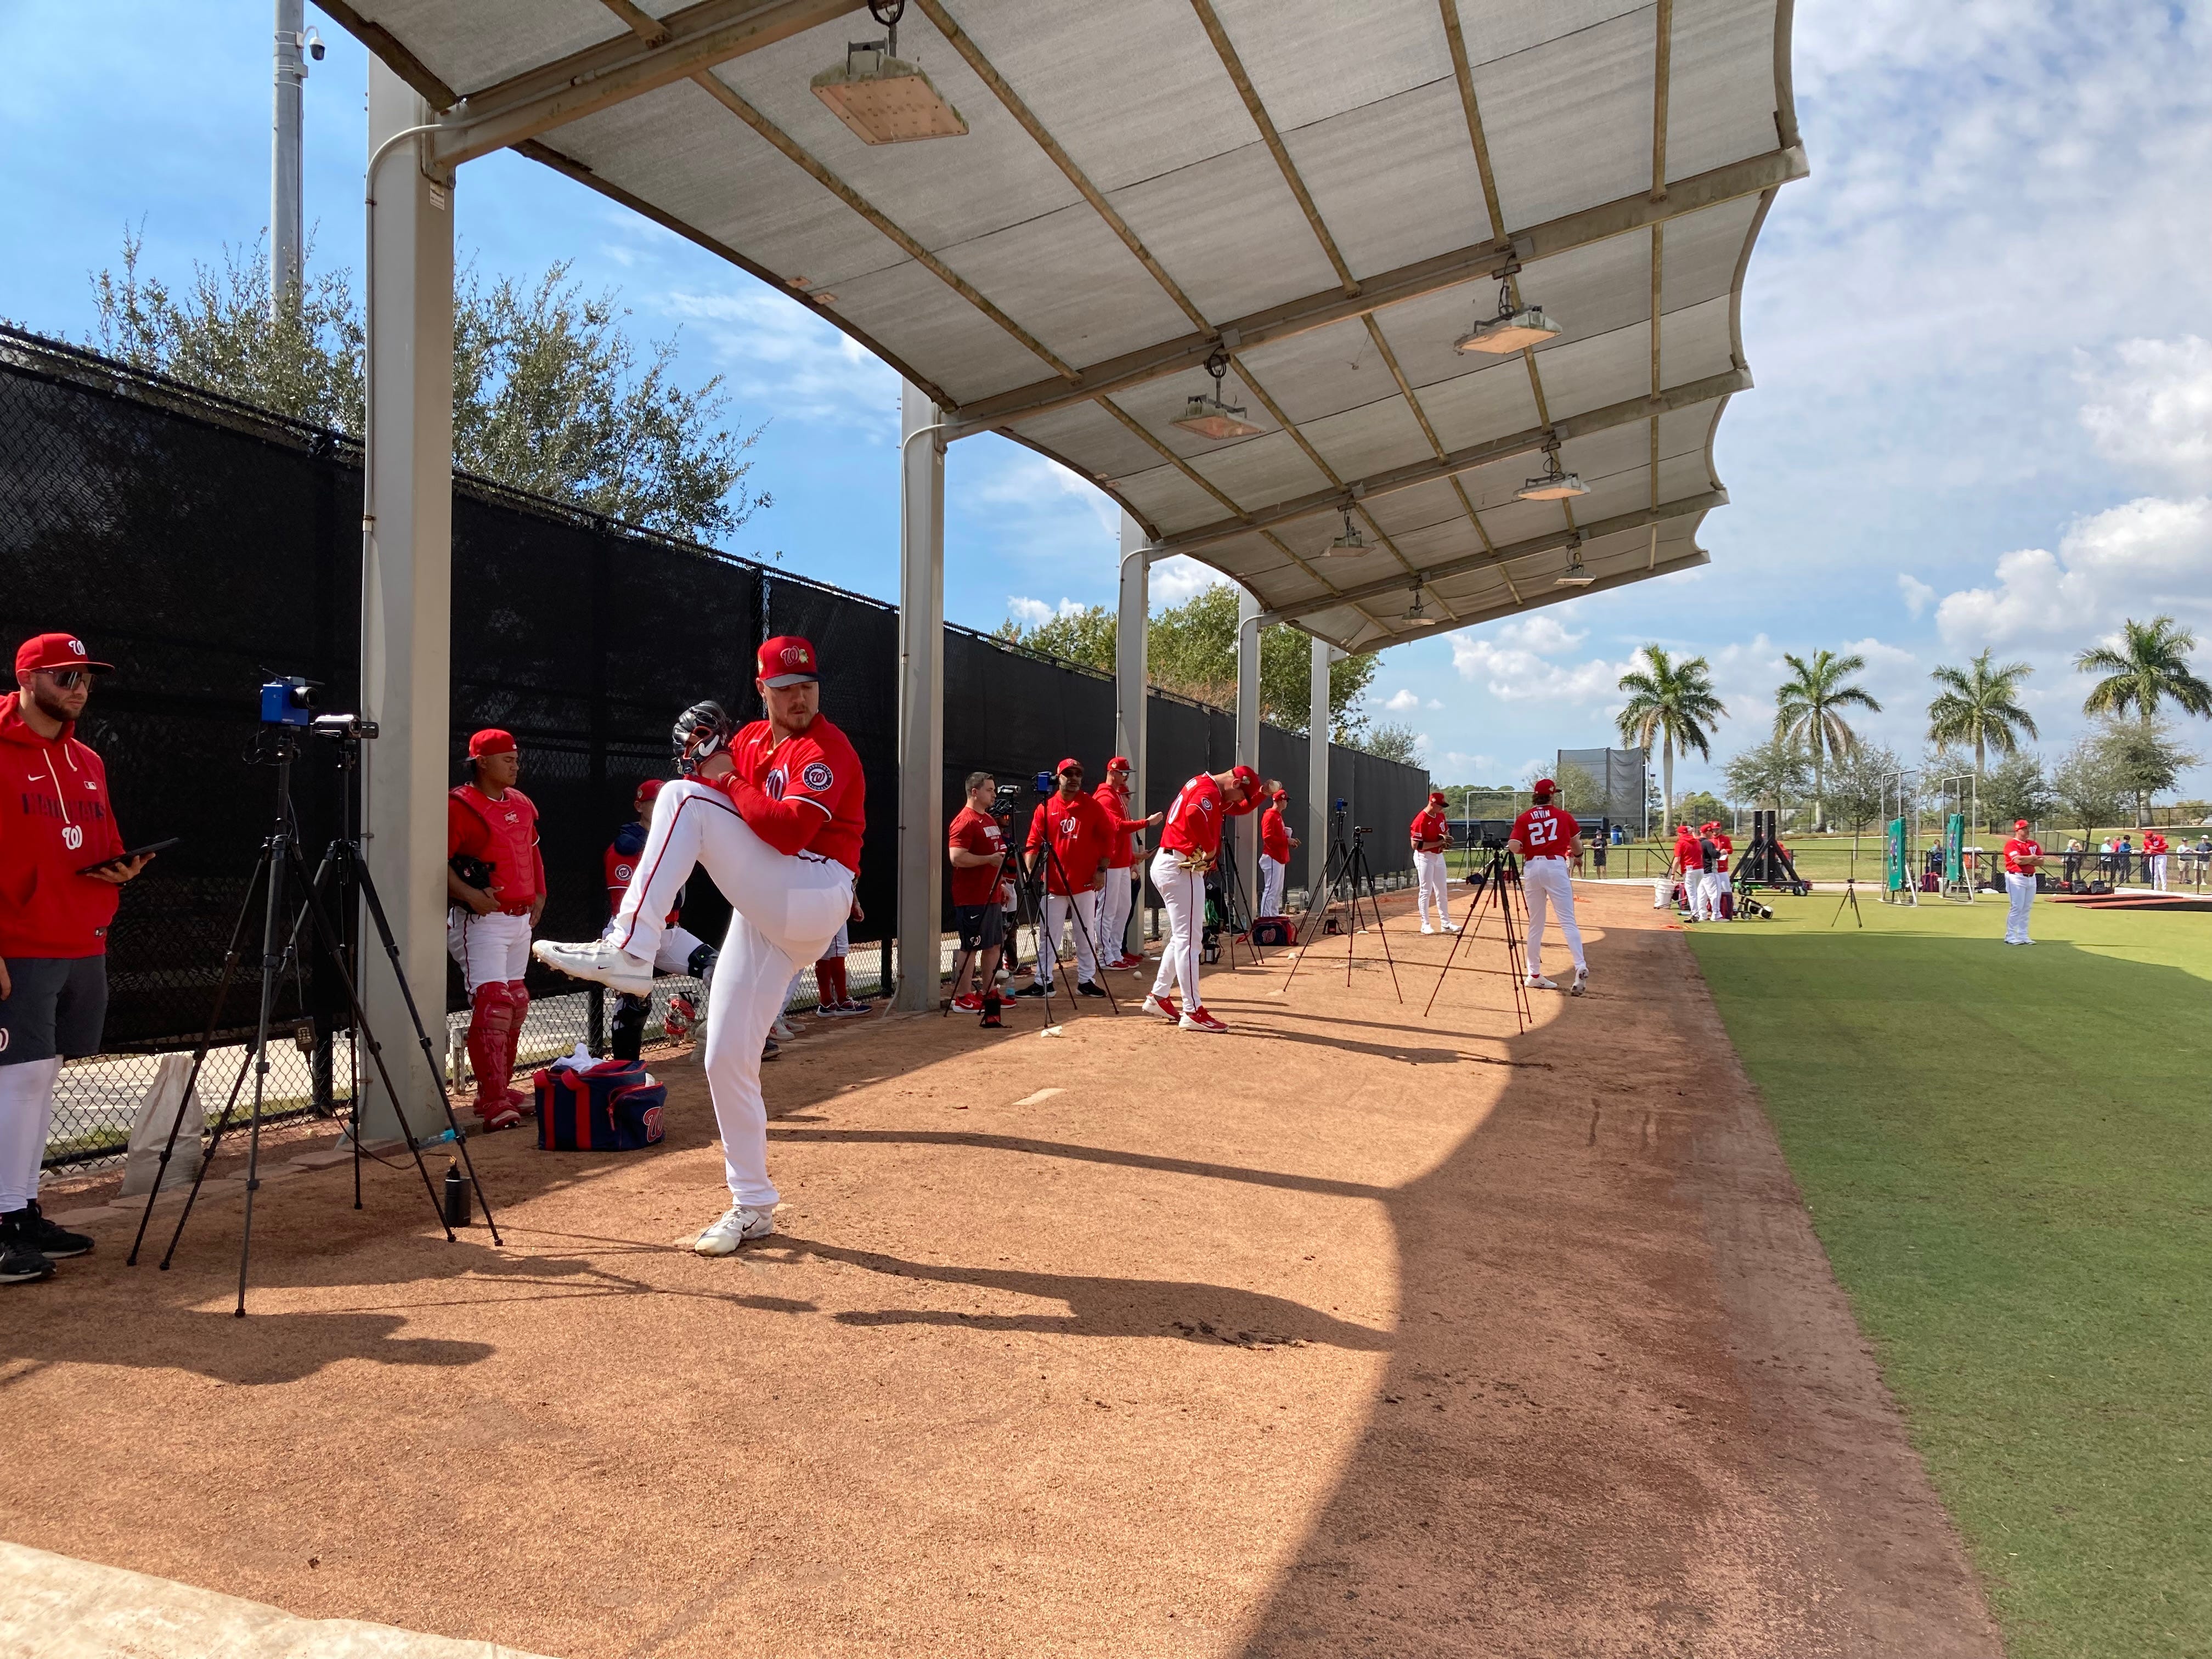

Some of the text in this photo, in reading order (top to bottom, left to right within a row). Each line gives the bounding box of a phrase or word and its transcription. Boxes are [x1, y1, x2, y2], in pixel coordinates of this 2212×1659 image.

[69, 640, 86, 656] W
[780, 645, 800, 667] W
[1060, 816, 1076, 833] W
[1530, 810, 1550, 820] IRVIN
[61, 825, 83, 850] W
[1528, 818, 1558, 846] 27
